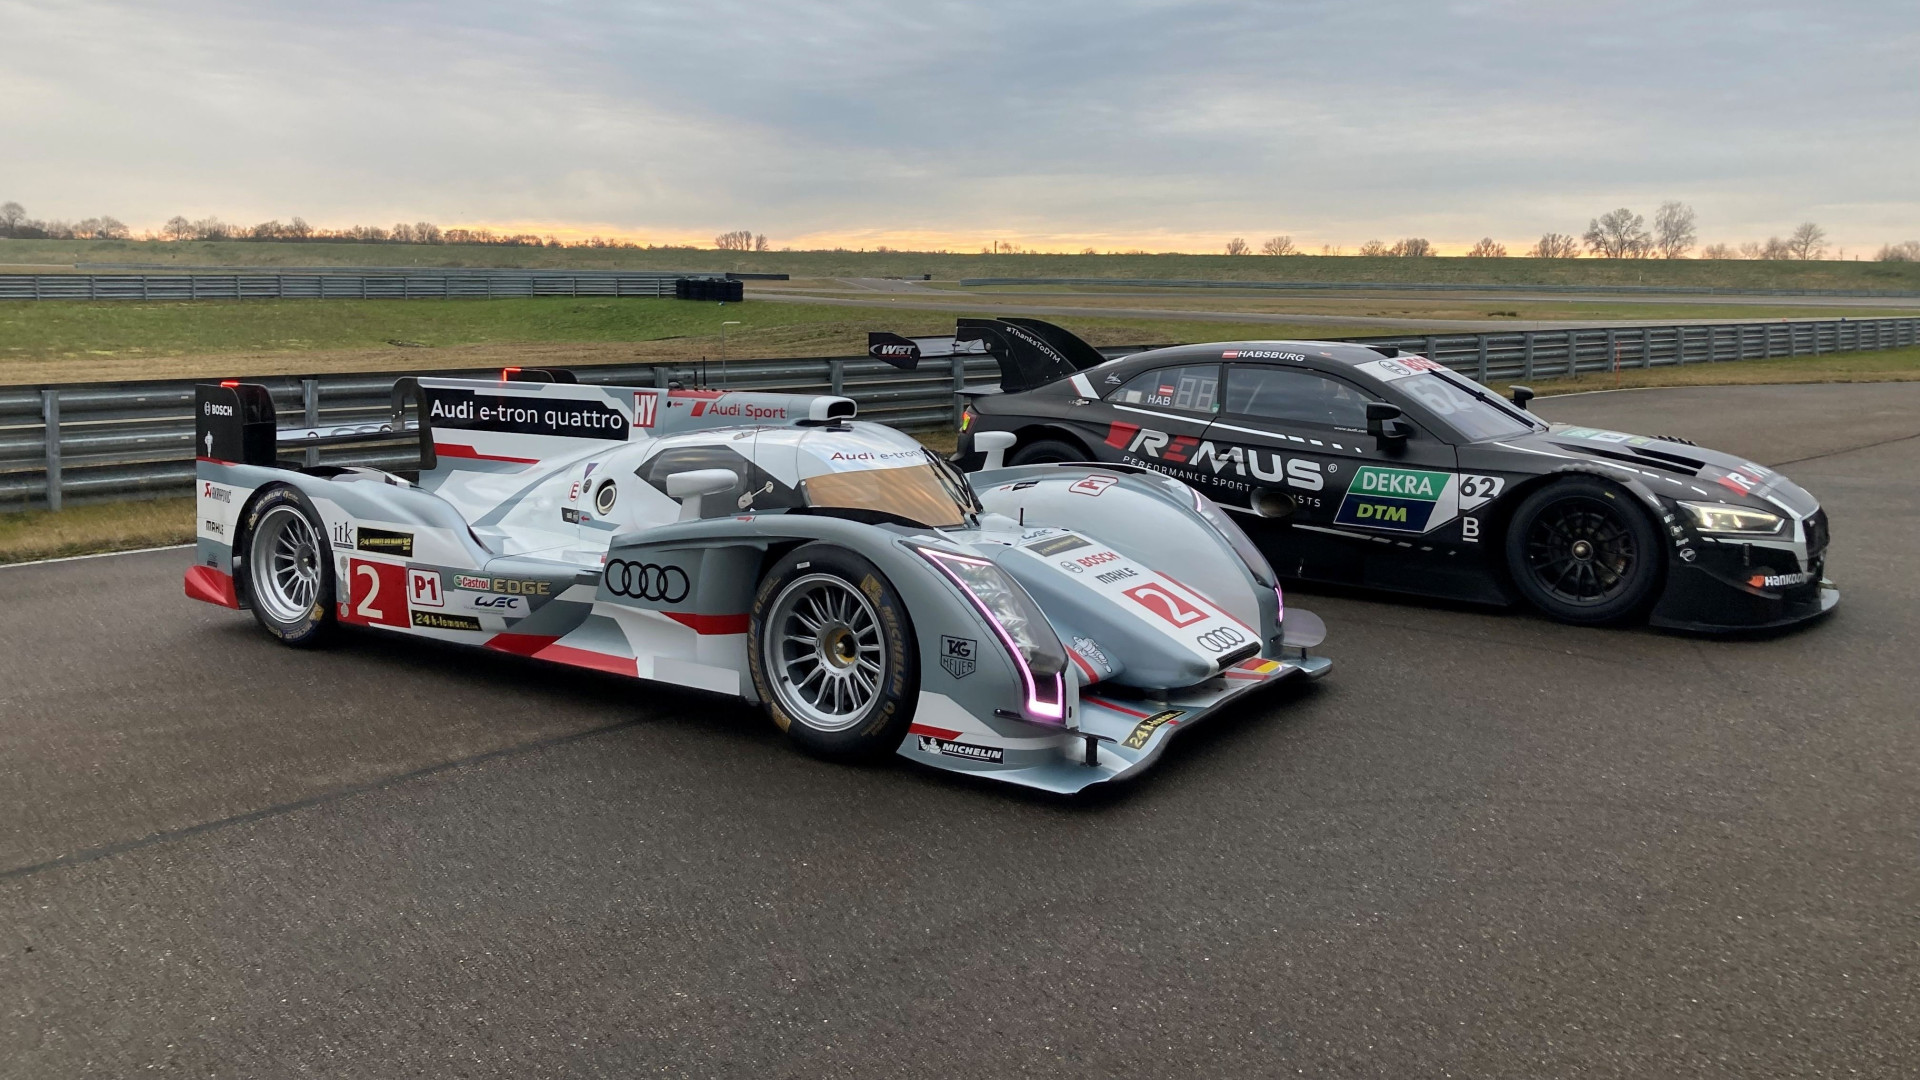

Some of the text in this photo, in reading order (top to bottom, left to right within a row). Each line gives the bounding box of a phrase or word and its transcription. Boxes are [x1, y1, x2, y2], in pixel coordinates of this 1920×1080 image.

[881, 344, 915, 356] WRT
[1005, 325, 1062, 365] #ThanksToDTM
[1238, 350, 1305, 362] HABSBURG
[1147, 394, 1171, 406] HAB
[1404, 378, 1473, 415] 62
[211, 404, 233, 417] BOSCH
[431, 399, 622, 430] Audi e-tron quattro
[634, 394, 658, 425] HY
[709, 402, 786, 420] Audi Sport
[831, 452, 875, 461] Audi
[880, 449, 919, 460] e-tron
[1128, 428, 1324, 492] REMUS
[1123, 455, 1250, 493] PERFORMANCE SPORT
[1362, 471, 1433, 496] DEKRA
[1077, 479, 1110, 491] P1
[1460, 476, 1496, 498] 62
[1357, 503, 1407, 523] DTM
[205, 520, 224, 536] MAHLE
[333, 521, 354, 543] itk
[1463, 517, 1480, 537] B
[1076, 551, 1121, 568] BOSCH
[1095, 567, 1139, 584] MAHLE
[357, 565, 383, 620] 2
[414, 575, 437, 600] P1
[462, 577, 551, 595] Castrol EDGE
[475, 596, 518, 609] WEC
[1135, 588, 1201, 624] 2
[881, 605, 906, 697] MICHELIN
[947, 639, 970, 658] TAG
[943, 658, 973, 677] HEUER
[942, 742, 1002, 759] MICHELIN
